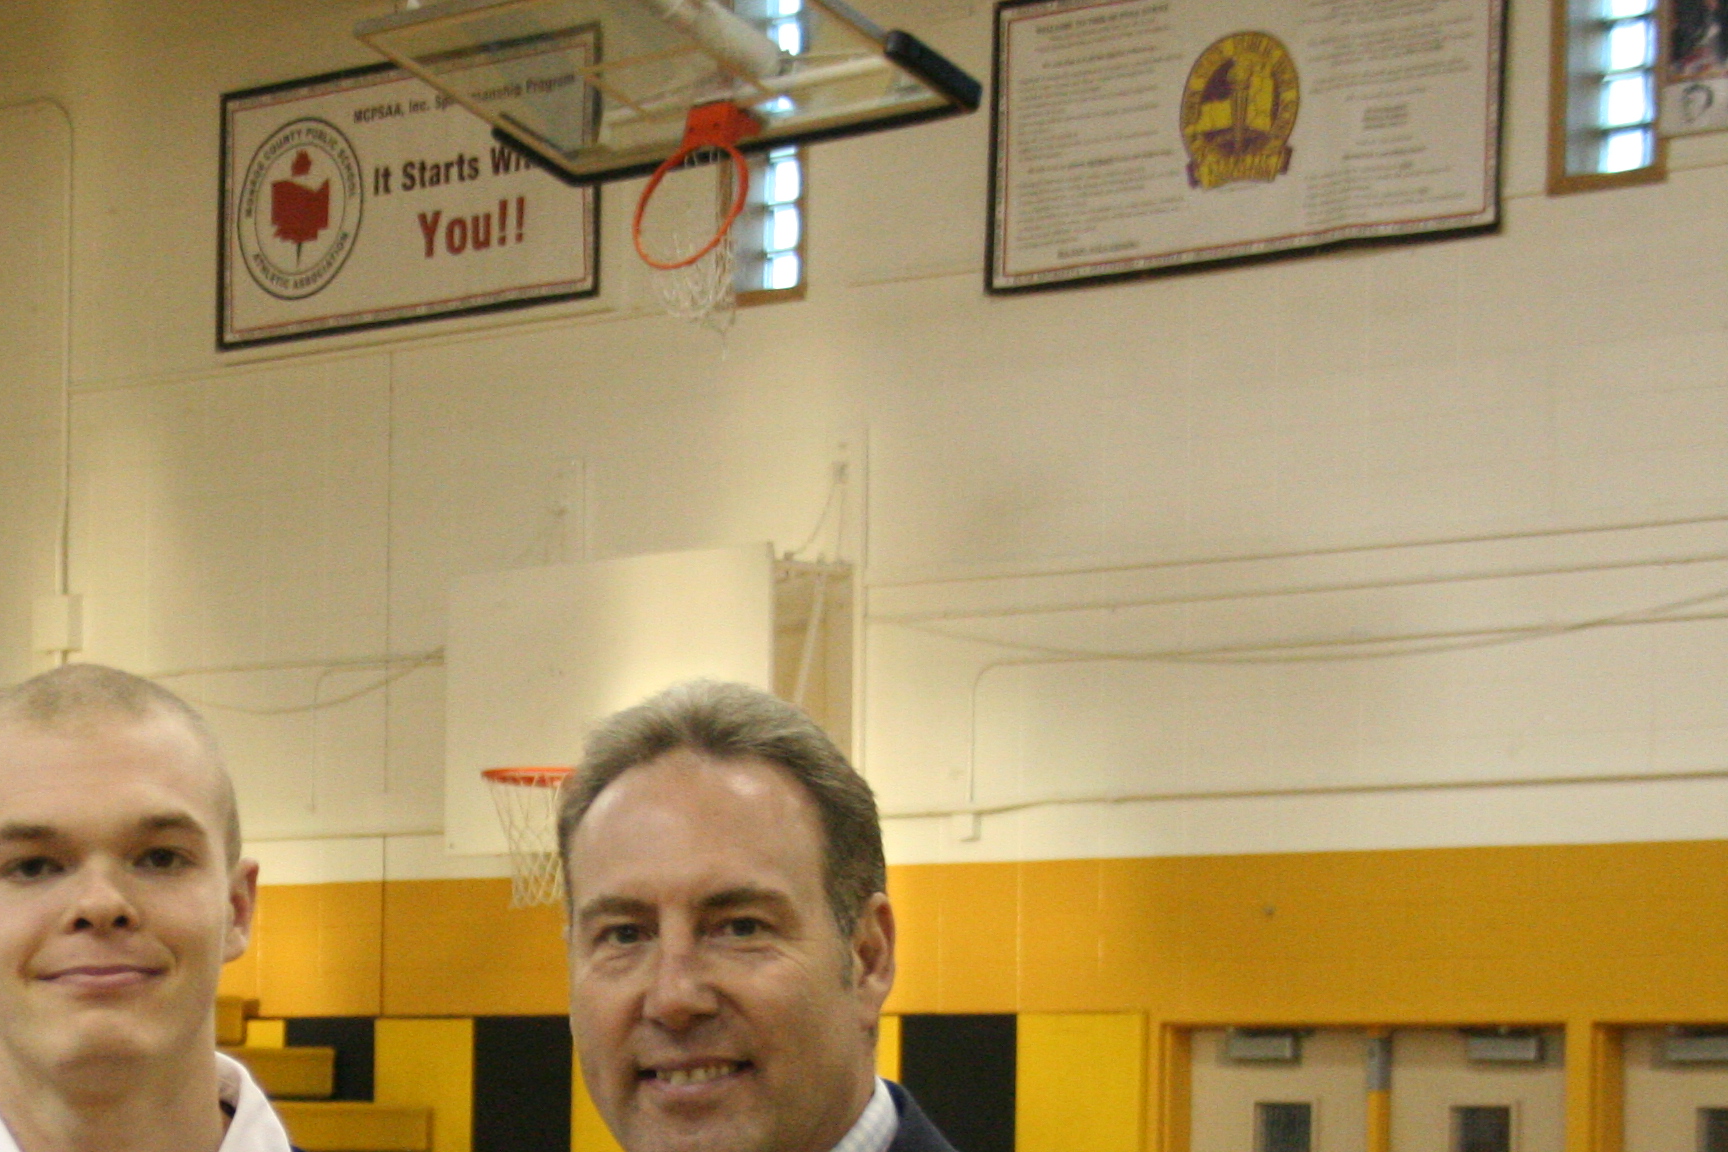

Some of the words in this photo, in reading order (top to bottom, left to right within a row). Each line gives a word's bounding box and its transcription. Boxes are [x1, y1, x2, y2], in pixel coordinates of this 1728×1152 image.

[374, 165, 392, 196] It
[401, 152, 480, 192] Starts
[417, 196, 526, 259] You!!
